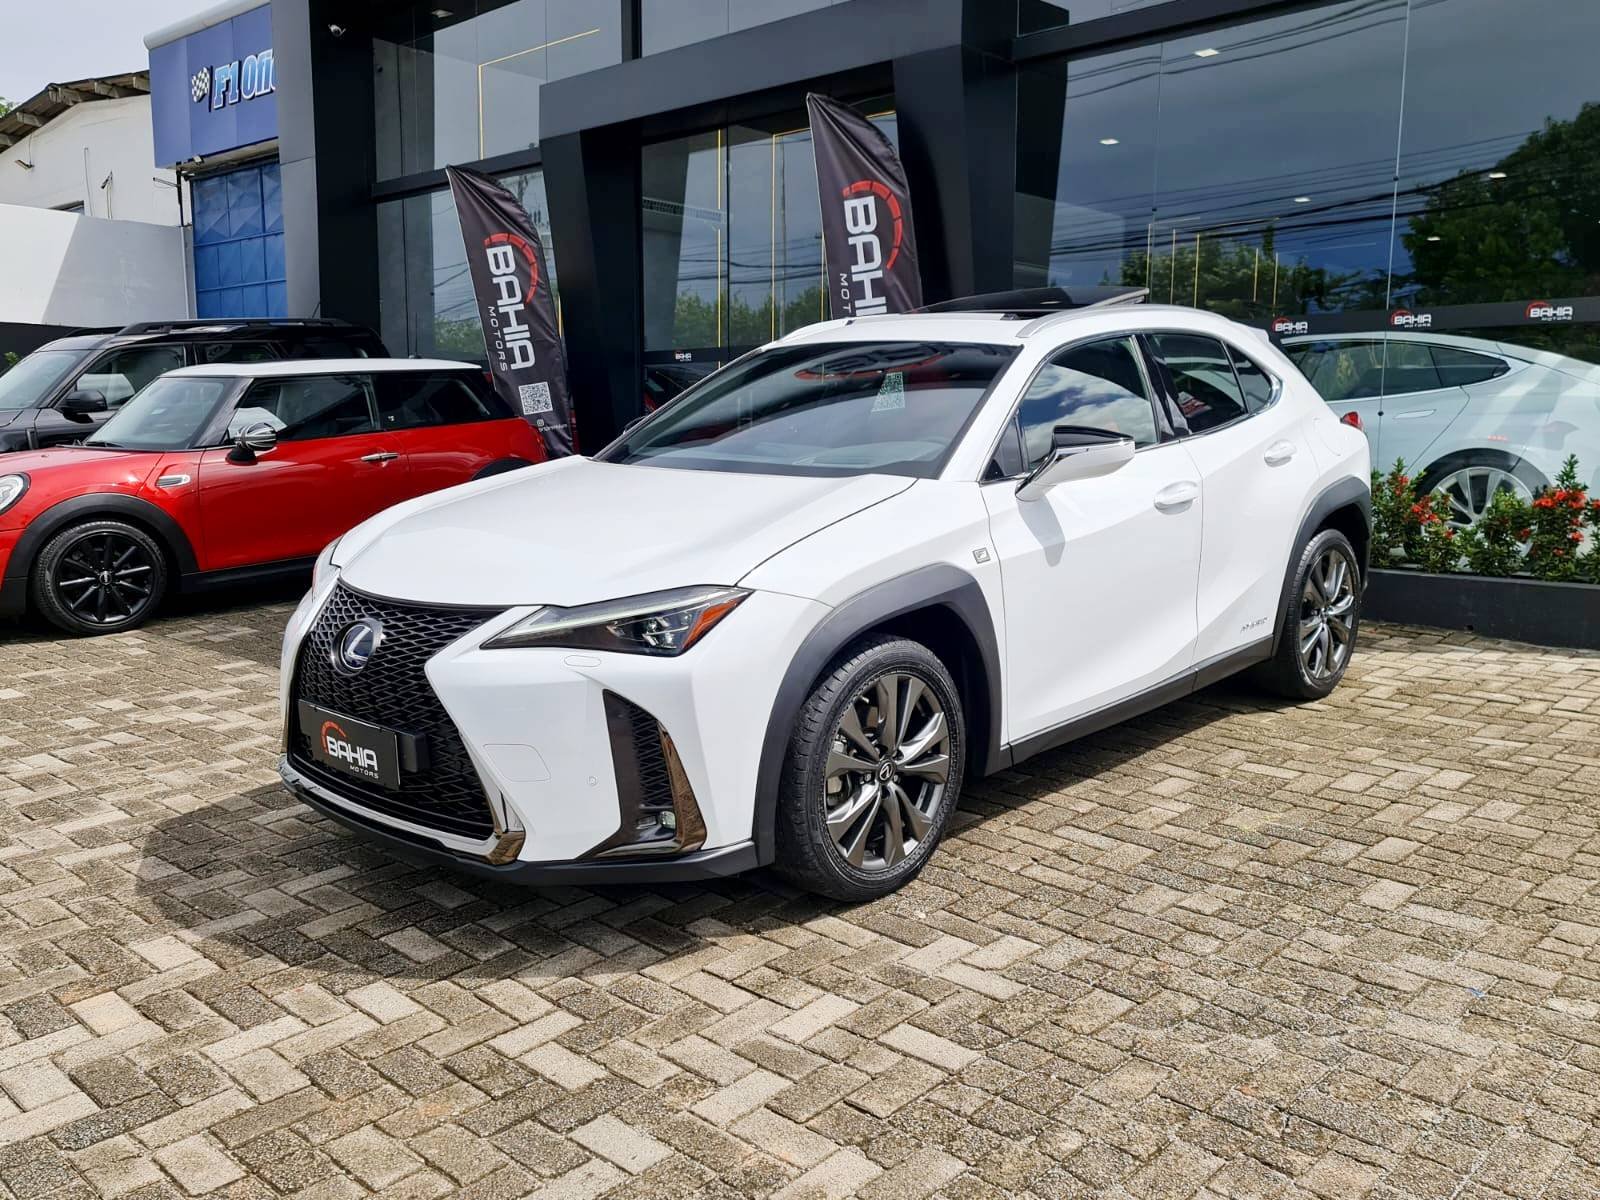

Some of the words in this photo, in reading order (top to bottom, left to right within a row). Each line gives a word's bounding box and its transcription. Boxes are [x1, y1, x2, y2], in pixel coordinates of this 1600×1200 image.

[213, 60, 240, 109] F1
[843, 195, 887, 317] BAHI
[486, 244, 536, 370] BAHIA
[839, 272, 852, 314] MOT
[1530, 306, 1573, 318] BAHIA
[488, 305, 508, 372] MOTORS
[1275, 321, 1308, 331] BAHIA
[1394, 314, 1432, 325] BAHIA
[326, 735, 378, 771] BAHIA
[349, 764, 379, 779] MOTORS
